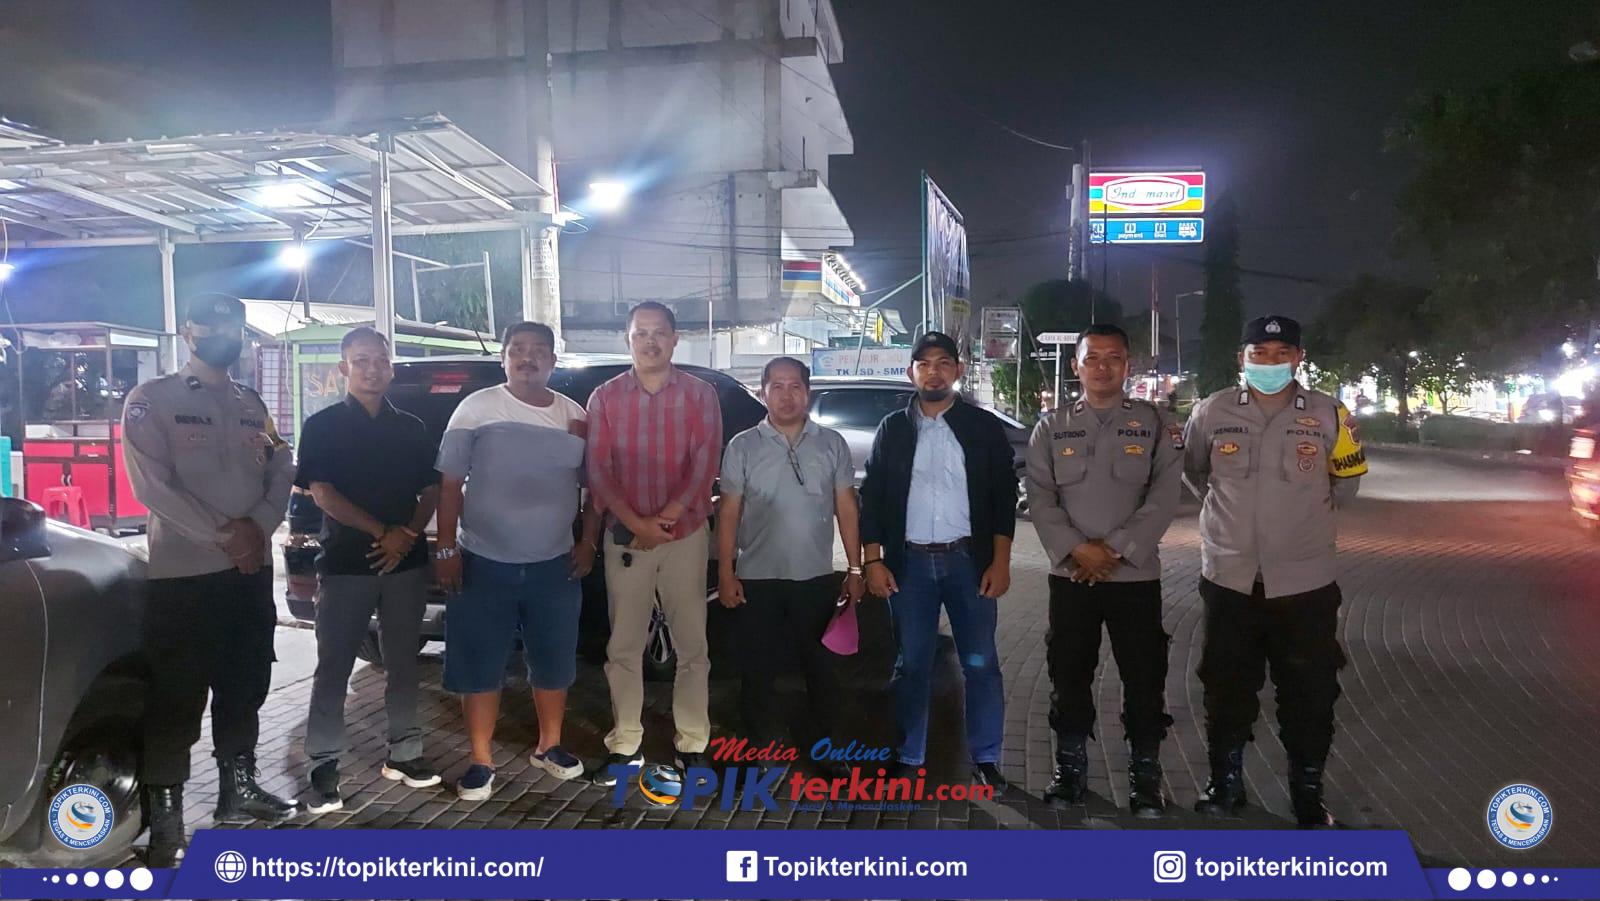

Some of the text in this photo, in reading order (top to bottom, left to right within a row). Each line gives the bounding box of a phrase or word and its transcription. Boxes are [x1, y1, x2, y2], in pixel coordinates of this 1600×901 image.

[1112, 186, 1181, 199] Indmaret
[860, 368, 874, 376] SD
[883, 367, 906, 375] SMP
[1117, 428, 1151, 438] POLRI
